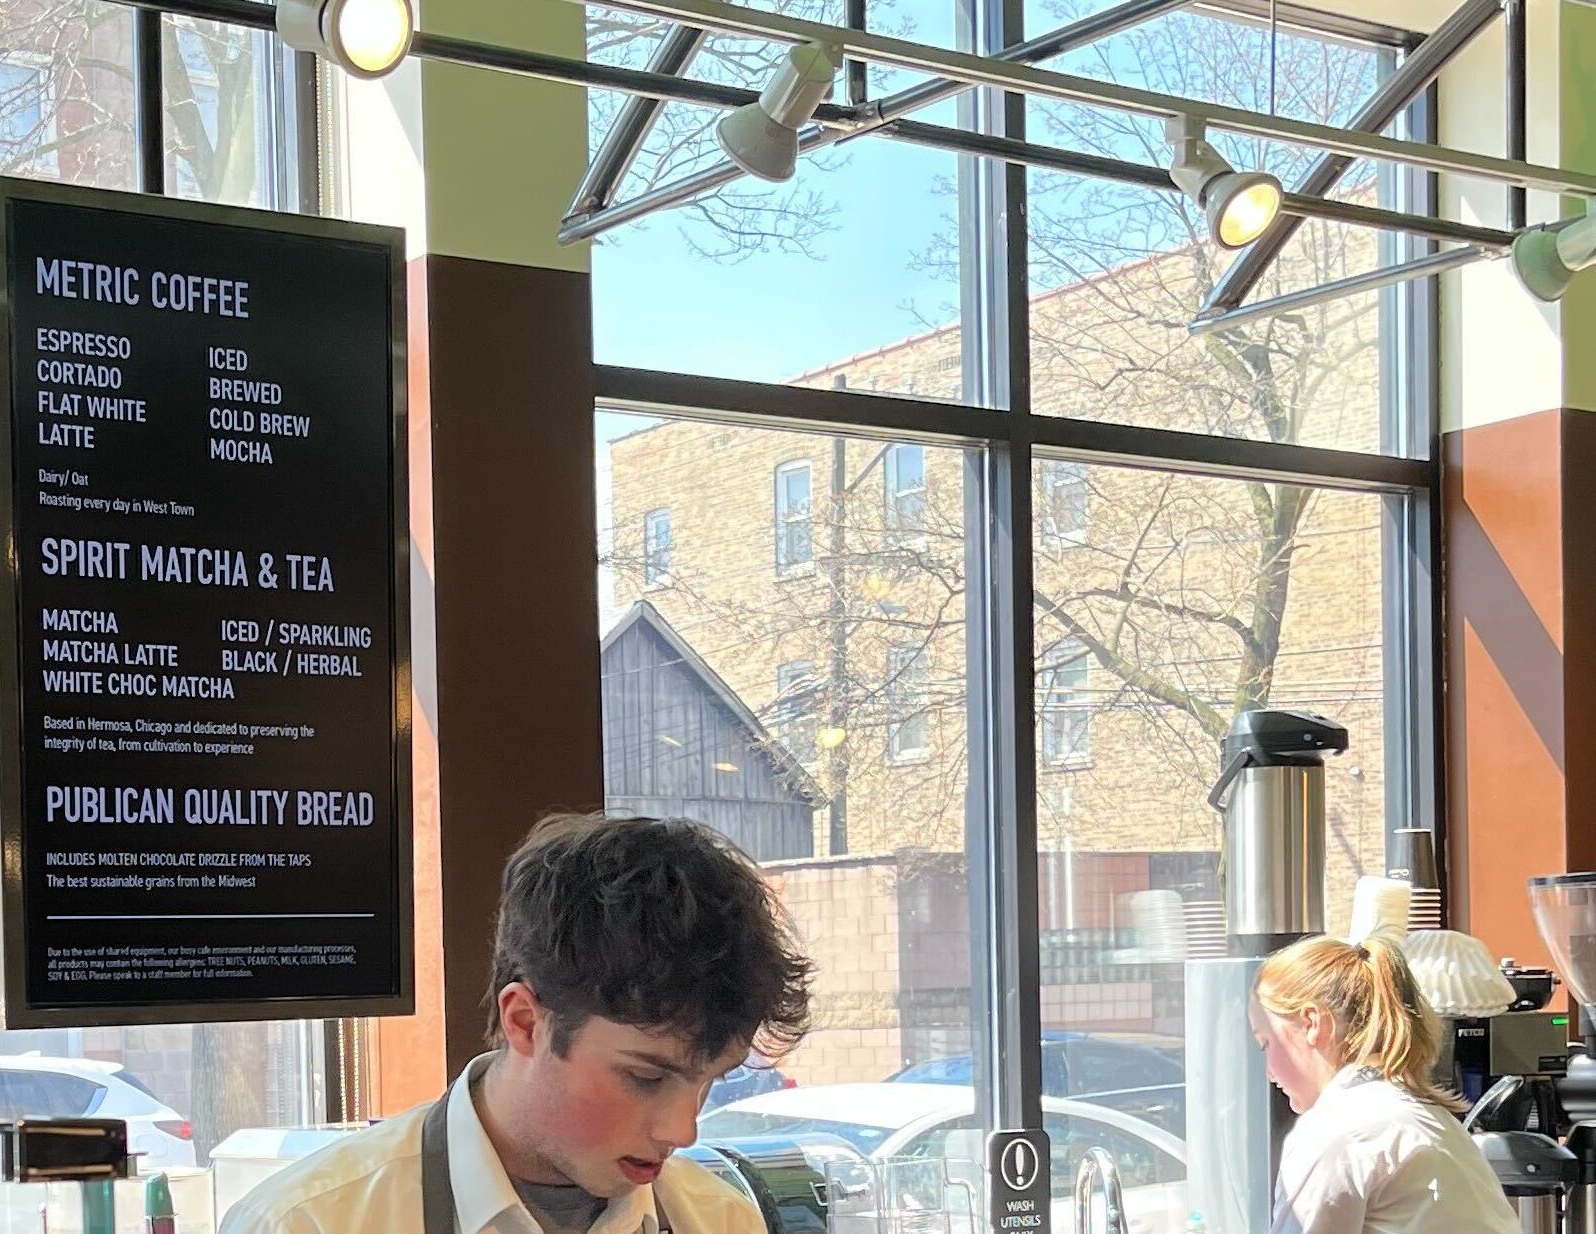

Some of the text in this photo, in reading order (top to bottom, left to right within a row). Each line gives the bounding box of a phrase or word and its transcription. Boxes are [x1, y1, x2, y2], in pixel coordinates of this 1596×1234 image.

[36, 256, 249, 319] METRIC COFFEE
[36, 327, 131, 360] ESPRESSO
[209, 346, 248, 372] ICED
[37, 359, 122, 390] CORTADO
[209, 377, 282, 405] BREWED
[38, 390, 147, 423] FLAT WHITE
[38, 421, 95, 449] LATTE
[209, 407, 311, 438] COLD BREW
[210, 437, 273, 465] MOCHA
[38, 468, 89, 487] Dairy/ Oat
[39, 490, 195, 517] Roasting every day West Town
[41, 537, 335, 592] SPIRIT MATCHA & TEA
[42, 608, 119, 634] MATCHA
[221, 619, 372, 649] ICED SPARKLING
[43, 639, 179, 667] MATCHA LATTE
[221, 649, 363, 677] BLACK HERBAL
[42, 669, 235, 699] WHITE CHOC MATCHA
[43, 715, 299, 741] Based Hermosa, Chicago and dedicated preserving
[43, 735, 255, 757] integrity tea, from cultivation experience
[46, 785, 374, 826] PUBLICAN QUALITY BREAD
[46, 852, 312, 867] INCLUDES MOLTEN CHOCOLATE DRIZZLE FROM THE TAPS
[46, 873, 256, 891] The best sustainable grains from Midwest
[1006, 1201, 1035, 1212] WASH
[1001, 1215, 1041, 1228] UTENSILS
